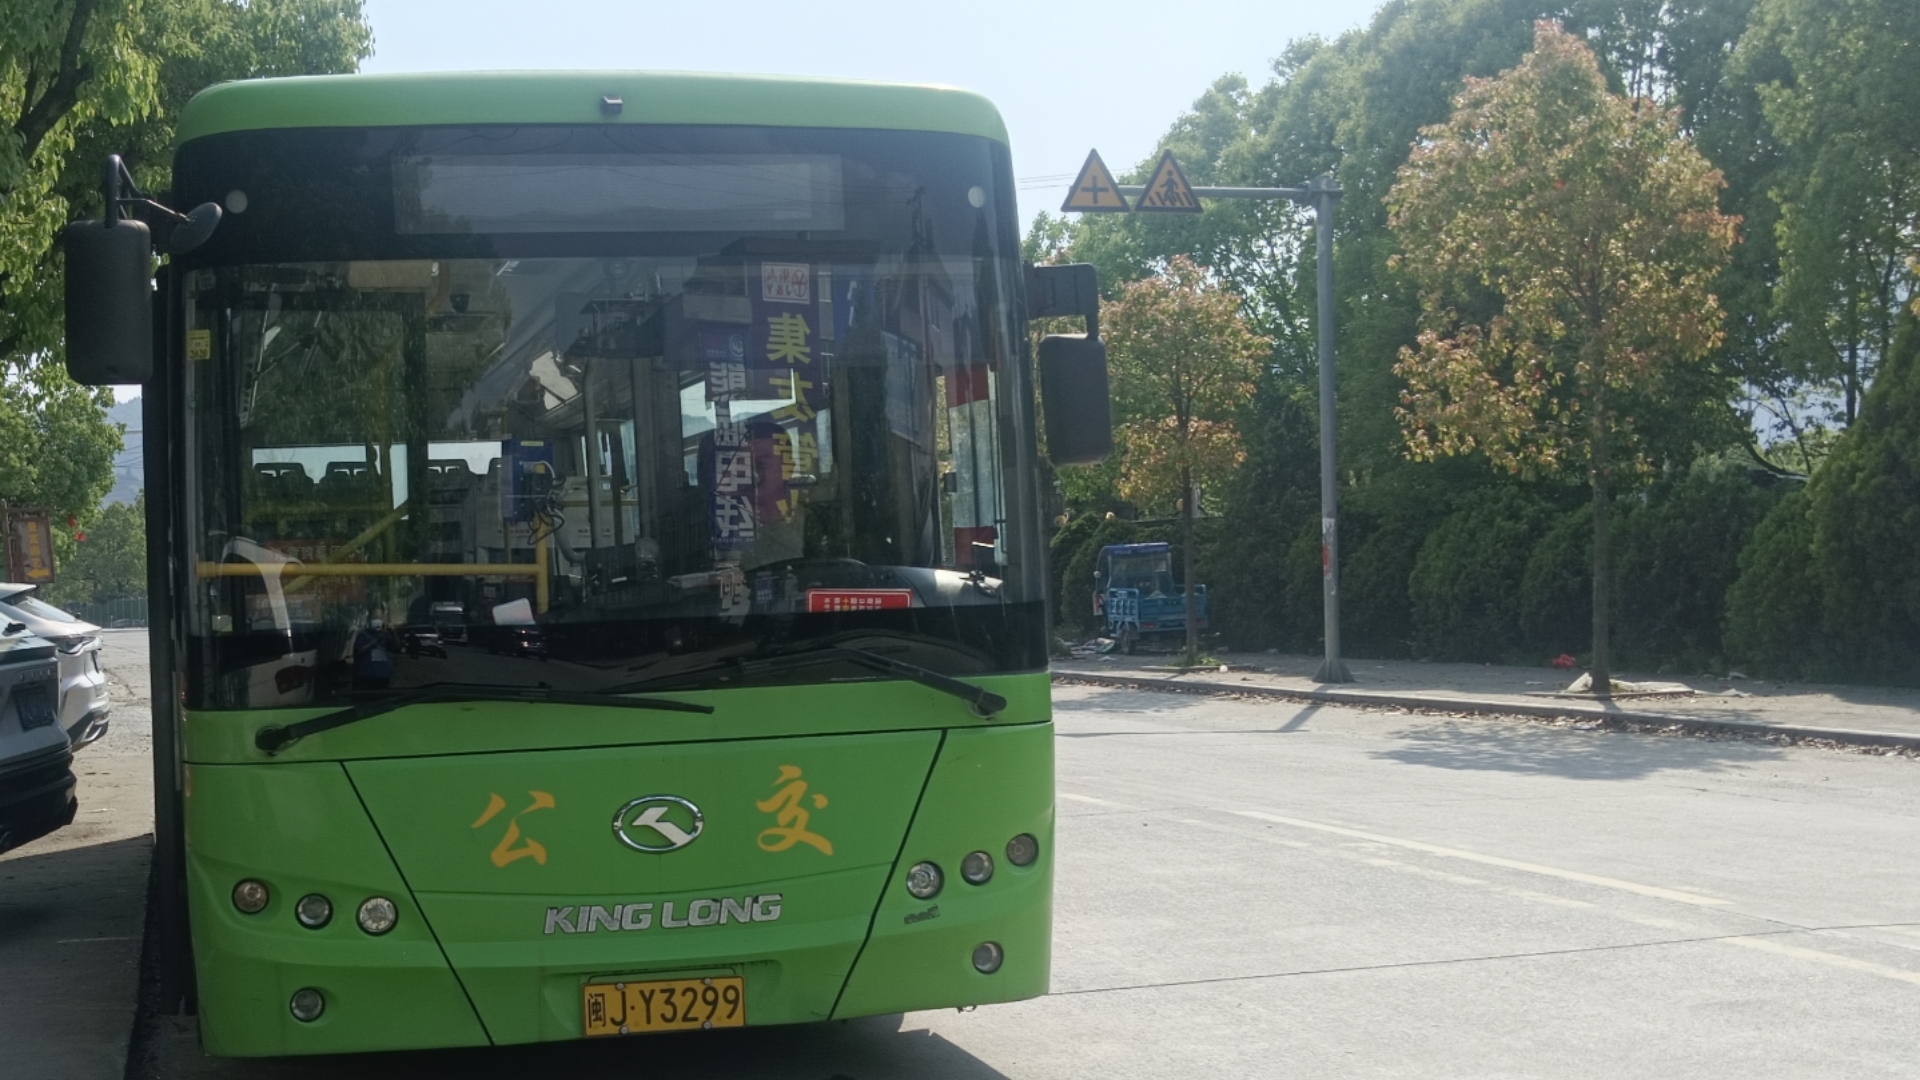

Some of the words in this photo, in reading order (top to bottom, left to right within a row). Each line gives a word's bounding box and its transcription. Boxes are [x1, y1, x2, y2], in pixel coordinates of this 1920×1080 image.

[471, 790, 556, 868] 公
[756, 765, 834, 856] 交
[543, 902, 654, 935] KING
[660, 893, 783, 929] LONG
